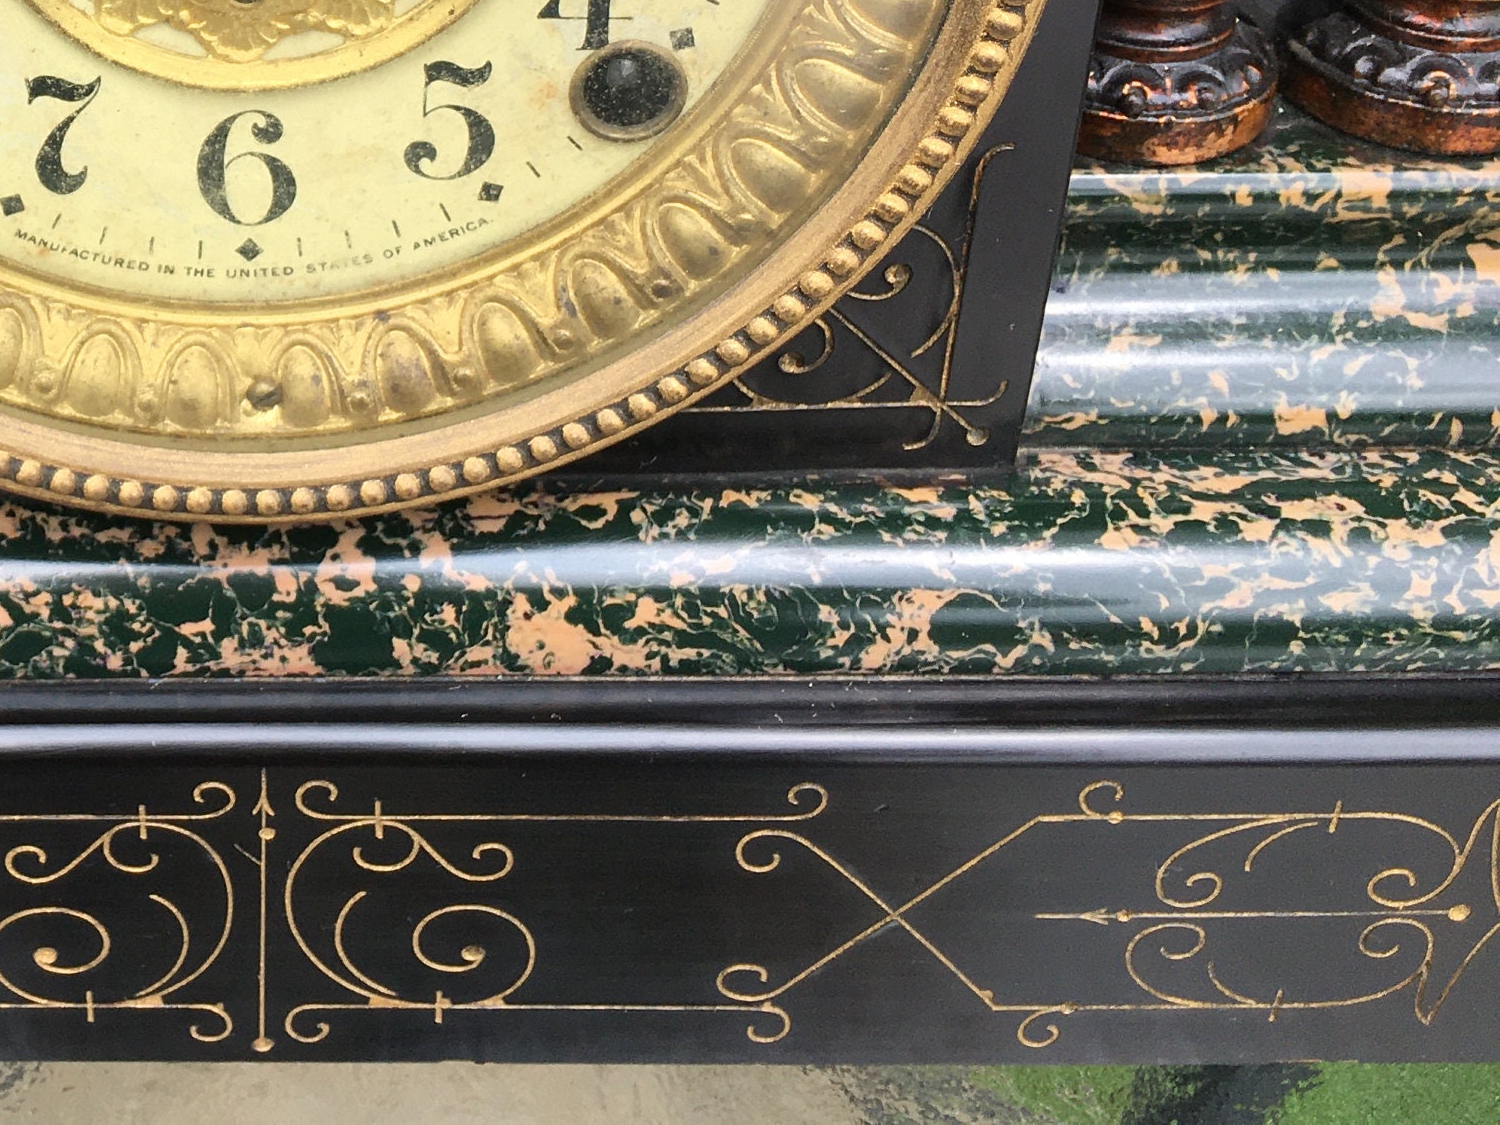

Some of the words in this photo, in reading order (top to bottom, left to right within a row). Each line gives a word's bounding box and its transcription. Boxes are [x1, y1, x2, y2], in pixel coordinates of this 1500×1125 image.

[26, 76, 101, 194] 7
[197, 110, 296, 224] 6
[404, 61, 495, 181] 5
[14, 228, 150, 273] MANUFACTURED
[157, 263, 176, 276] IN
[185, 266, 216, 279] THE
[226, 265, 295, 280] UNITED
[383, 245, 403, 260] OF
[412, 216, 495, 252] AMERICA.
